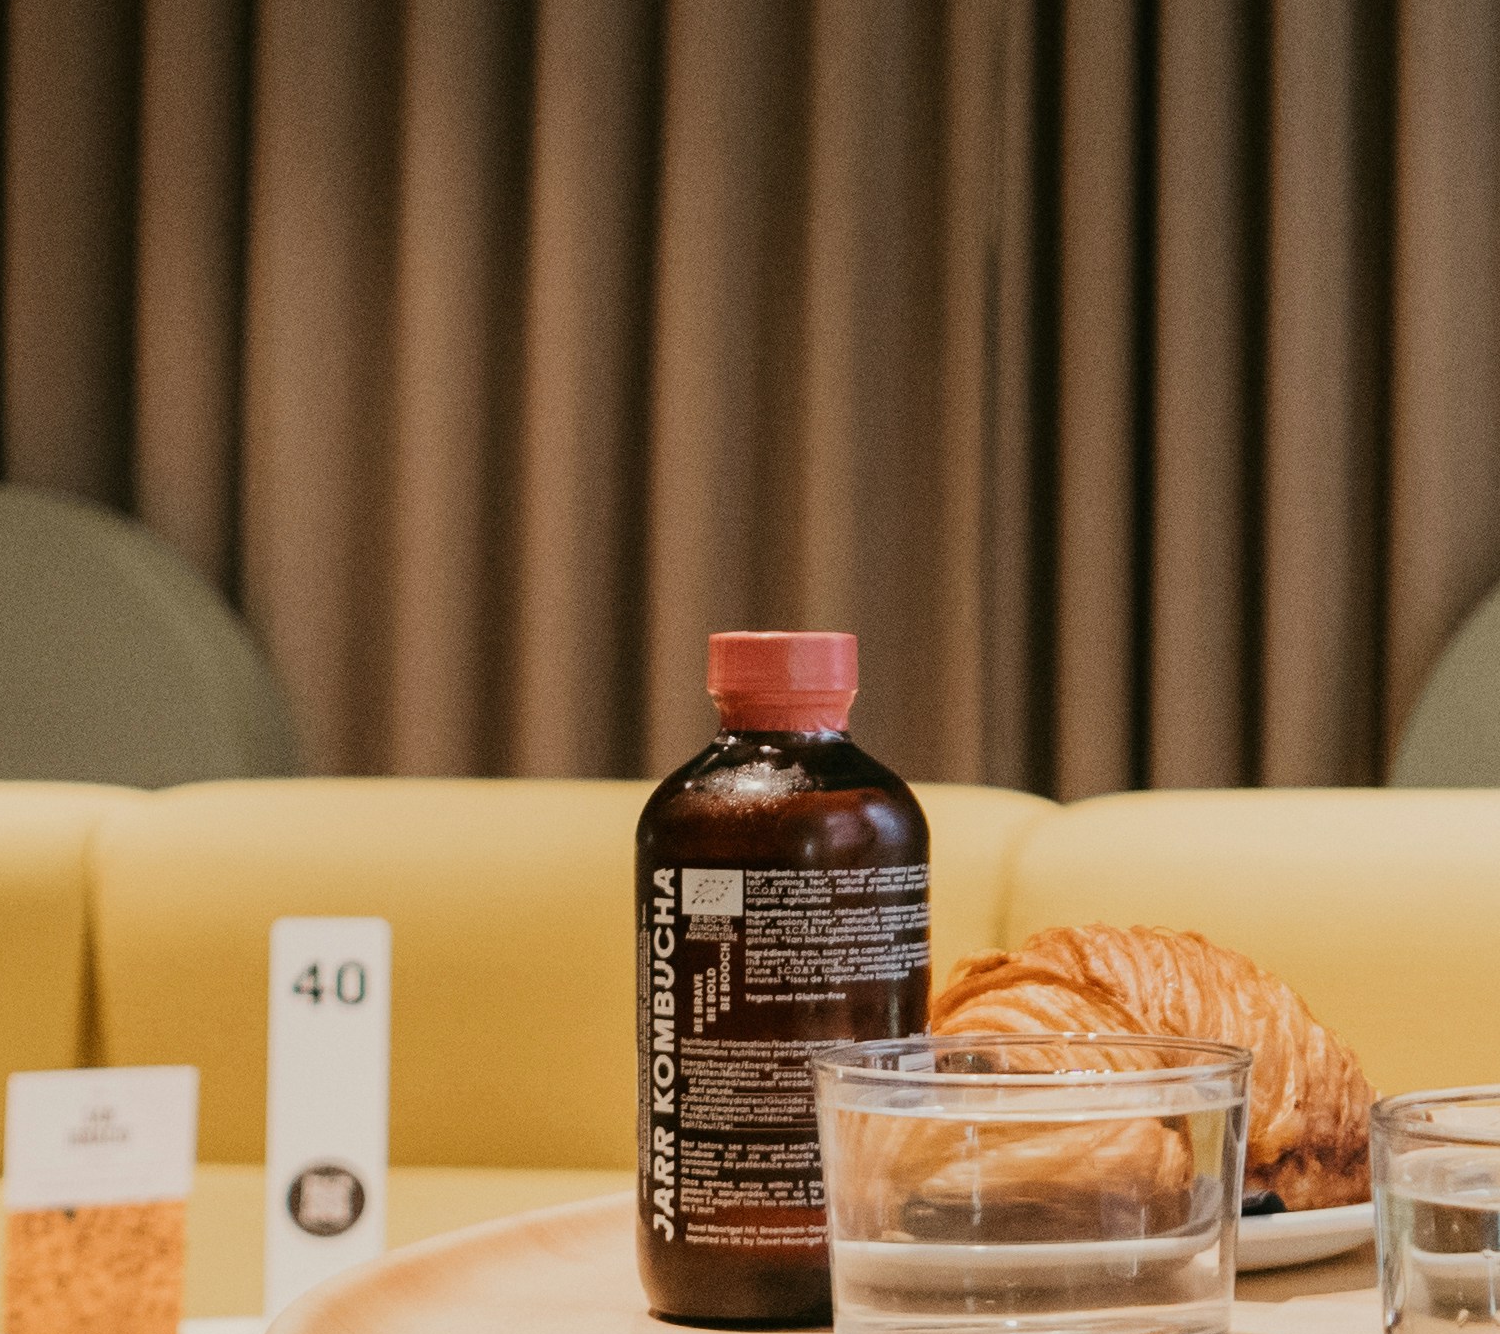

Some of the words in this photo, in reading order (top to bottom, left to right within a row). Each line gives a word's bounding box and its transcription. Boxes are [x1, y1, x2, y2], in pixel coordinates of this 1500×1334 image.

[746, 869, 797, 878] Ingredients:
[799, 869, 826, 877] water,
[772, 879, 805, 888] oolong
[835, 877, 865, 885] natural
[746, 896, 780, 906] organic
[783, 895, 831, 905] agriculture
[776, 918, 809, 927] oolong
[685, 931, 738, 941] AGRICULTURE
[746, 927, 762, 935] met
[765, 927, 782, 935] een
[805, 933, 855, 944] biologische
[849, 947, 859, 956] de
[719, 942, 730, 992] BOOCH
[292, 961, 367, 1006] 40
[810, 975, 822, 983] de
[706, 967, 716, 1003] BOLD
[653, 867, 675, 1116] KOMBUCHA
[693, 974, 703, 1014] BRAVE
[719, 995, 730, 1011] BE
[745, 992, 773, 1003] Vegan
[775, 992, 793, 1001] and
[706, 1006, 716, 1022] BE
[693, 1017, 703, 1033] BE
[680, 1139, 695, 1148] Best
[746, 1143, 785, 1151] coloured
[723, 1160, 734, 1168] de
[653, 1127, 675, 1242] JARR
[680, 1177, 699, 1186] Once
[739, 1181, 763, 1189] enjoy
[743, 1237, 755, 1246] by
[756, 1237, 781, 1245] Duvel
[782, 1236, 823, 1247] Moortgat
